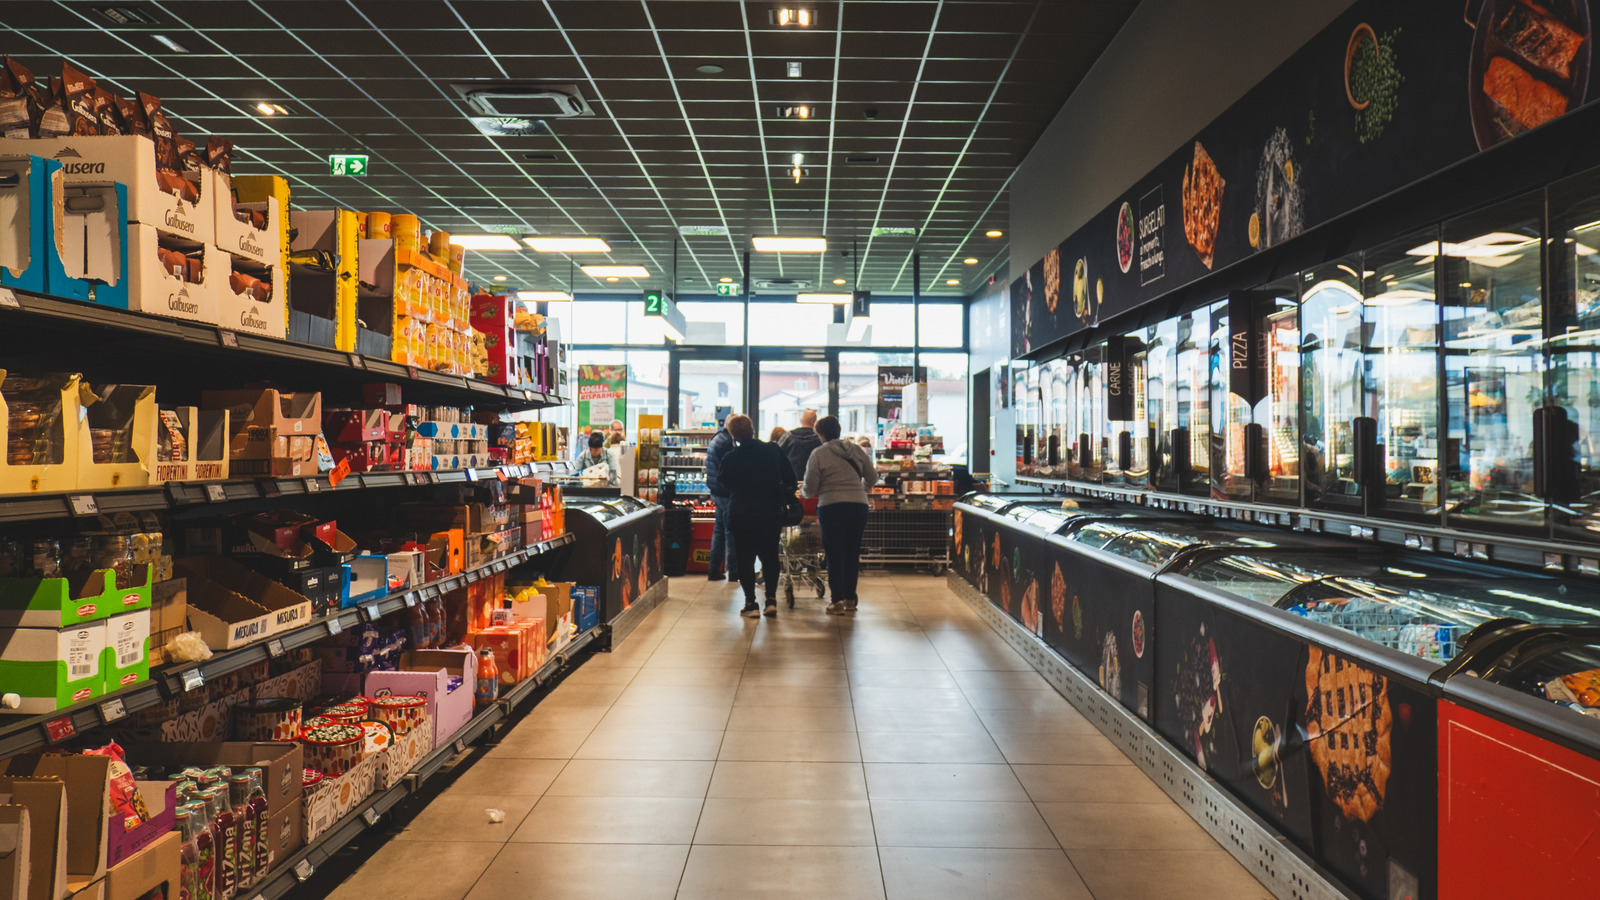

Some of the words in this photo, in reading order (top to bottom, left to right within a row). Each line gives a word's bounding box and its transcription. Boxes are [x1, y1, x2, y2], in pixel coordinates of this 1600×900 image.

[62, 161, 105, 175] usera
[164, 208, 195, 234] Galbusera
[1138, 204, 1166, 240] SURGELATI
[238, 235, 264, 257] Galbusera
[168, 293, 199, 315] Galbusera
[647, 294, 659, 312] 2
[857, 297, 865, 312] 1
[240, 310, 267, 331] Galbusera
[1232, 331, 1248, 370] PIZZA
[580, 384, 603, 393] COGLI
[1109, 362, 1121, 397] CARNE
[156, 465, 188, 481] FIORENTINI
